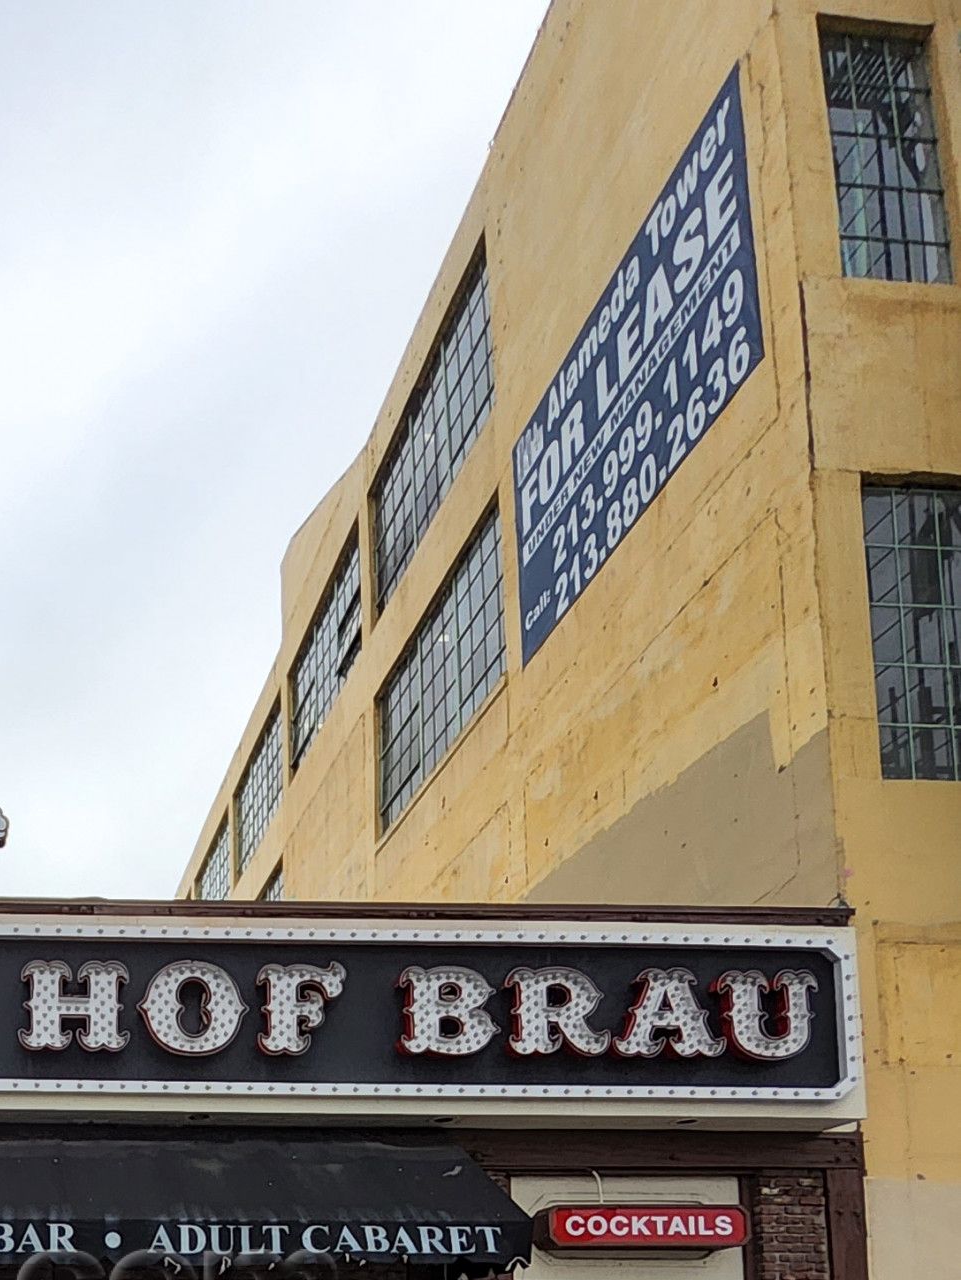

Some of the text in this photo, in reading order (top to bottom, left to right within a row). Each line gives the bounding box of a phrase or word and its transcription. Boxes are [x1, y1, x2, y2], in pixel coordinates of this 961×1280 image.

[521, 148, 737, 538] FOR LEASE
[528, 230, 737, 557] UNDER NEW MANAGEMENT
[547, 96, 731, 433] Alameda Tower
[524, 325, 750, 632] Call: 213.880.2636
[552, 268, 744, 574] 213.999.1149
[18, 958, 347, 1057] HOF
[396, 966, 816, 1061] BRAU
[147, 1222, 289, 1257] ADULT
[301, 1224, 504, 1257] CABARET
[564, 1212, 734, 1238] COCKTAILS
